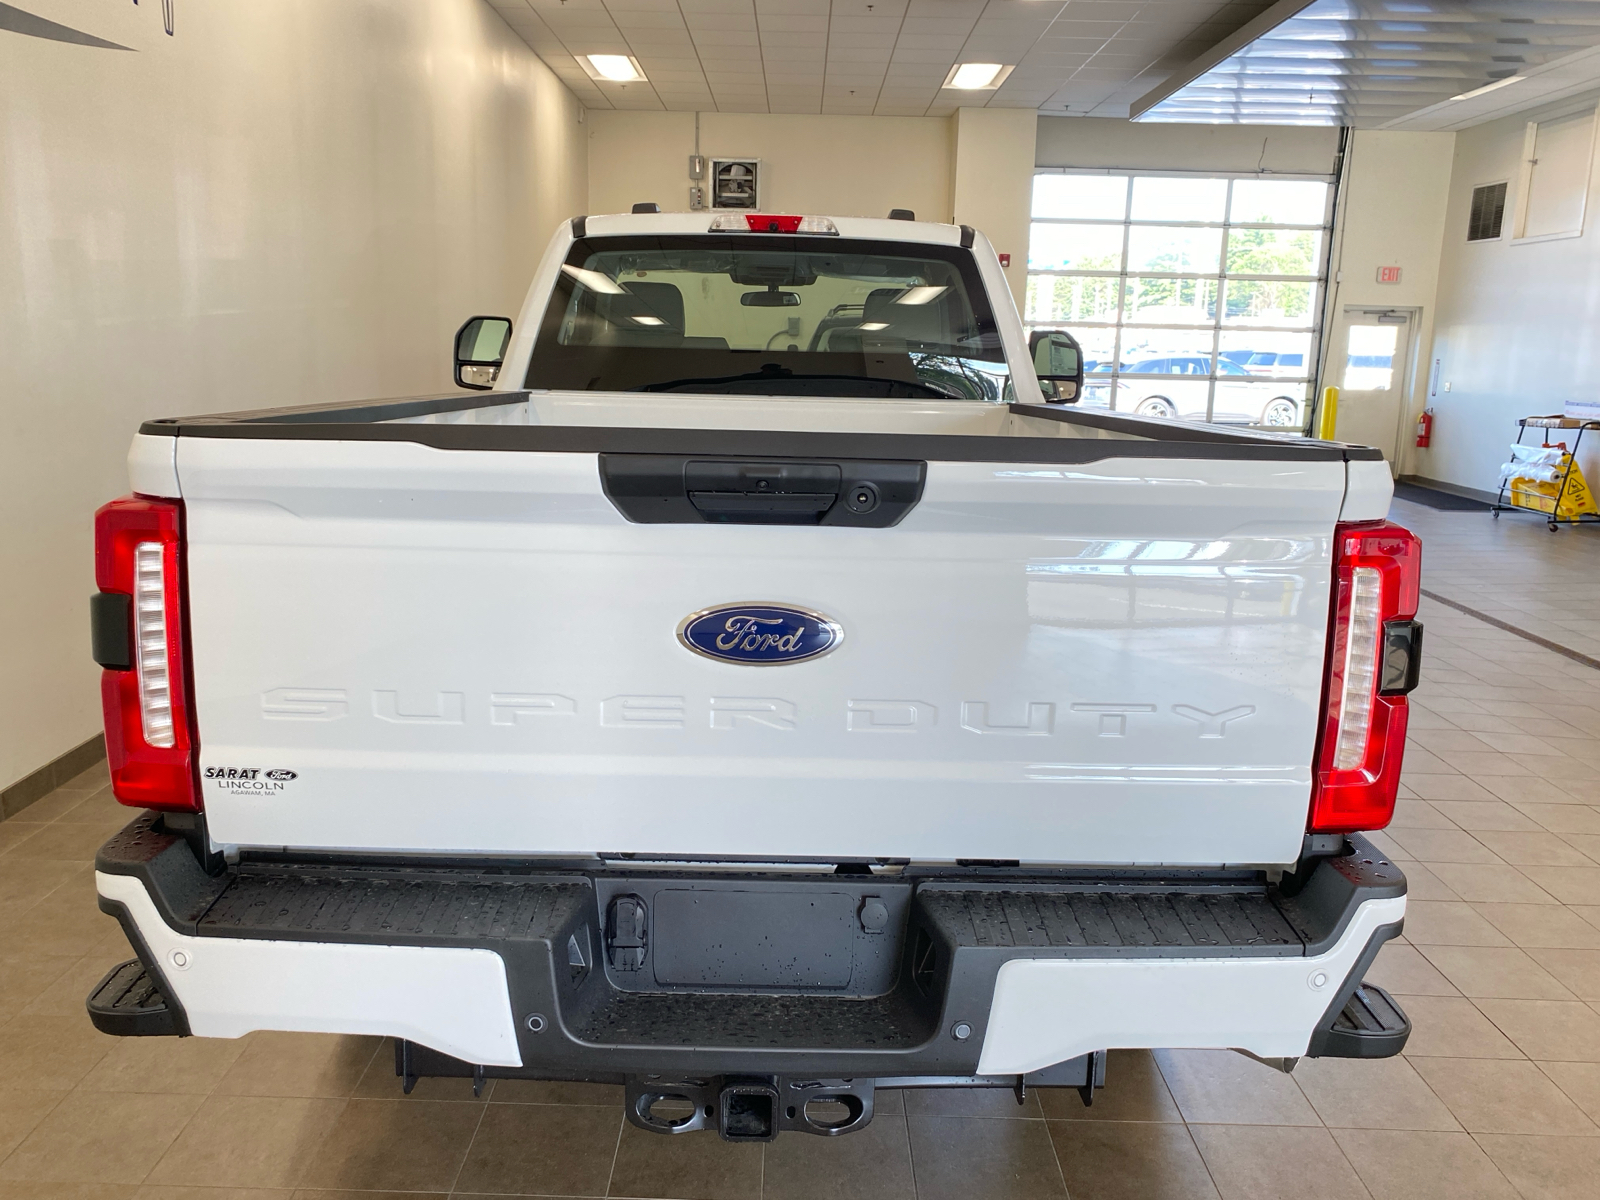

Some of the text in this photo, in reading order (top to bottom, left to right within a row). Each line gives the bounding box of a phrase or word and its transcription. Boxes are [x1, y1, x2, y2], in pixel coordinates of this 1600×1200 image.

[1381, 266, 1401, 282] EXIT
[715, 615, 805, 652] Ford
[261, 686, 1257, 739] SUPER DUTY
[205, 767, 294, 781] SARAT Ford
[218, 780, 284, 790] LINCOLN
